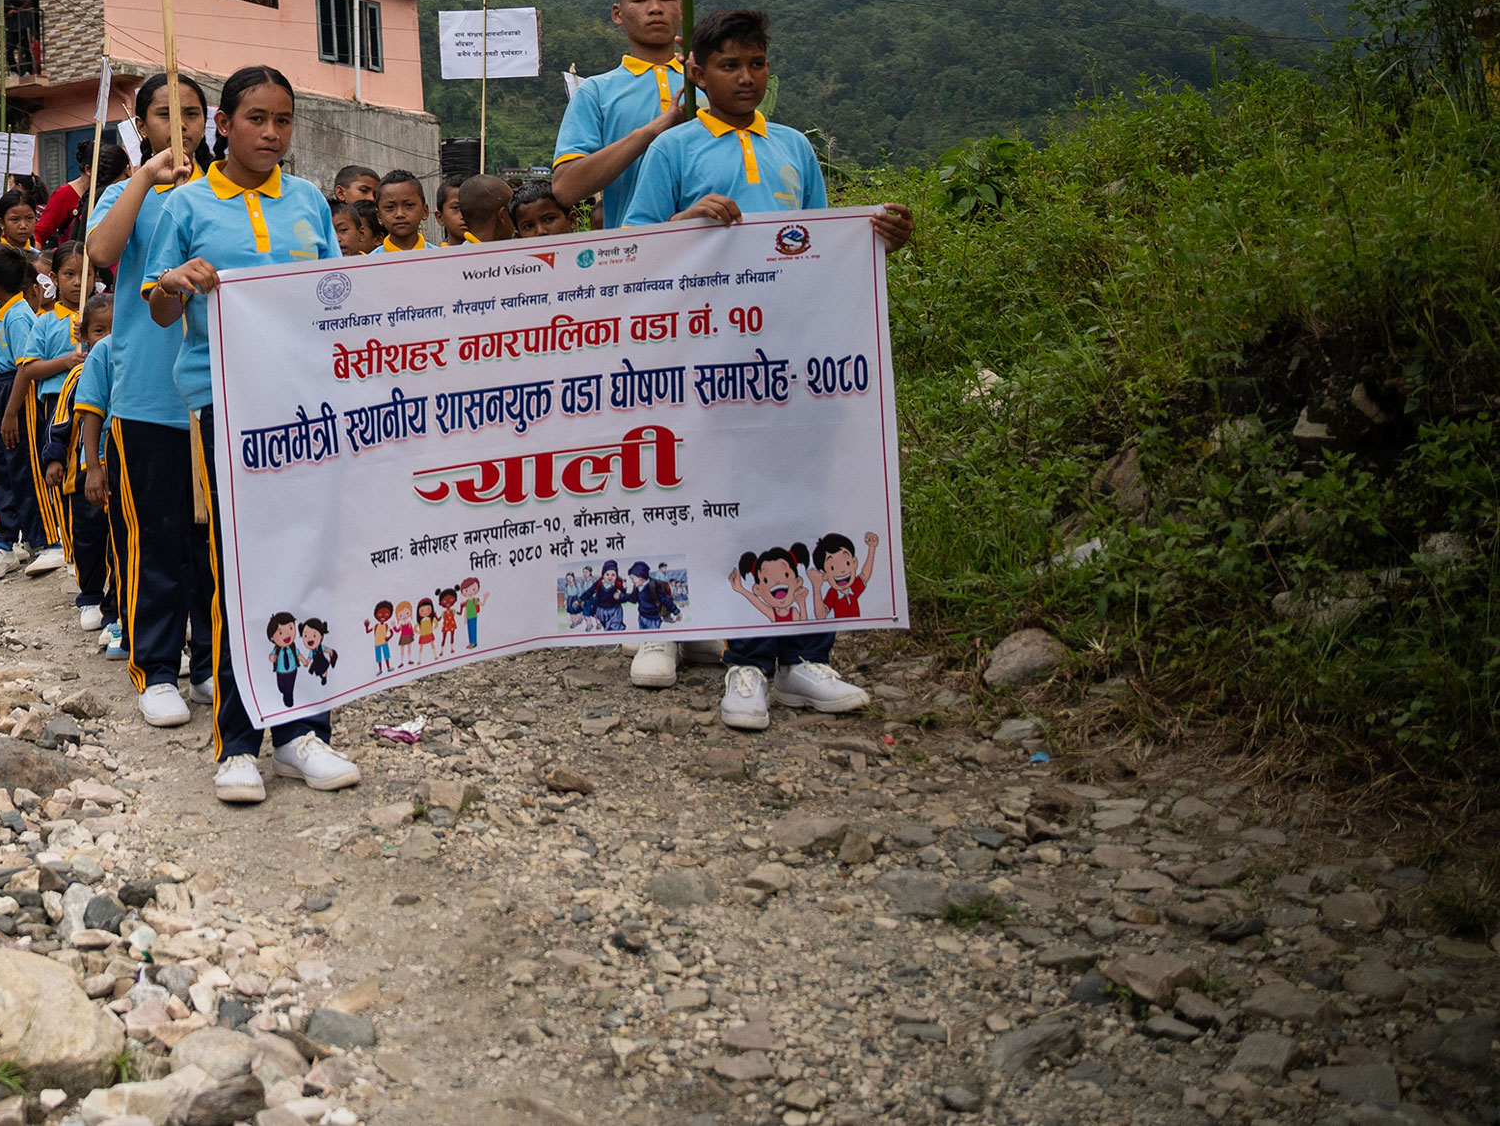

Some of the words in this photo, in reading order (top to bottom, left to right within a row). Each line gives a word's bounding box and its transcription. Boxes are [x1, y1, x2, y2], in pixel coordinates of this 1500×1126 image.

[452, 296, 496, 316] गौरवपूर्ण
[500, 292, 551, 311] स्वाभिमान,
[557, 284, 596, 303] बालमैत्री
[600, 285, 619, 298] वडा
[623, 279, 674, 295] कार्यान्वयन
[678, 274, 731, 292] दीर्घकालीन
[462, 266, 501, 281] World
[503, 263, 542, 276] Vision
[332, 338, 450, 380] बेसीशहर
[458, 313, 622, 362] नगरपालिका
[630, 311, 680, 342] वडा
[688, 302, 718, 337] नं.
[728, 305, 764, 335] १०
[241, 401, 340, 469] बालमैत्री
[344, 387, 428, 452] स्थानीय
[435, 380, 554, 434] शासनयुक्त
[560, 374, 603, 414] वडा
[610, 358, 686, 409] घोषणा
[806, 354, 870, 394] २०८०
[410, 533, 458, 557] बेसीशहर
[642, 505, 694, 526] लमजुङ,
[702, 500, 741, 519] नेपाल
[509, 545, 542, 567] २०८०
[550, 535, 574, 558] भदौ
[606, 532, 626, 551] गते
